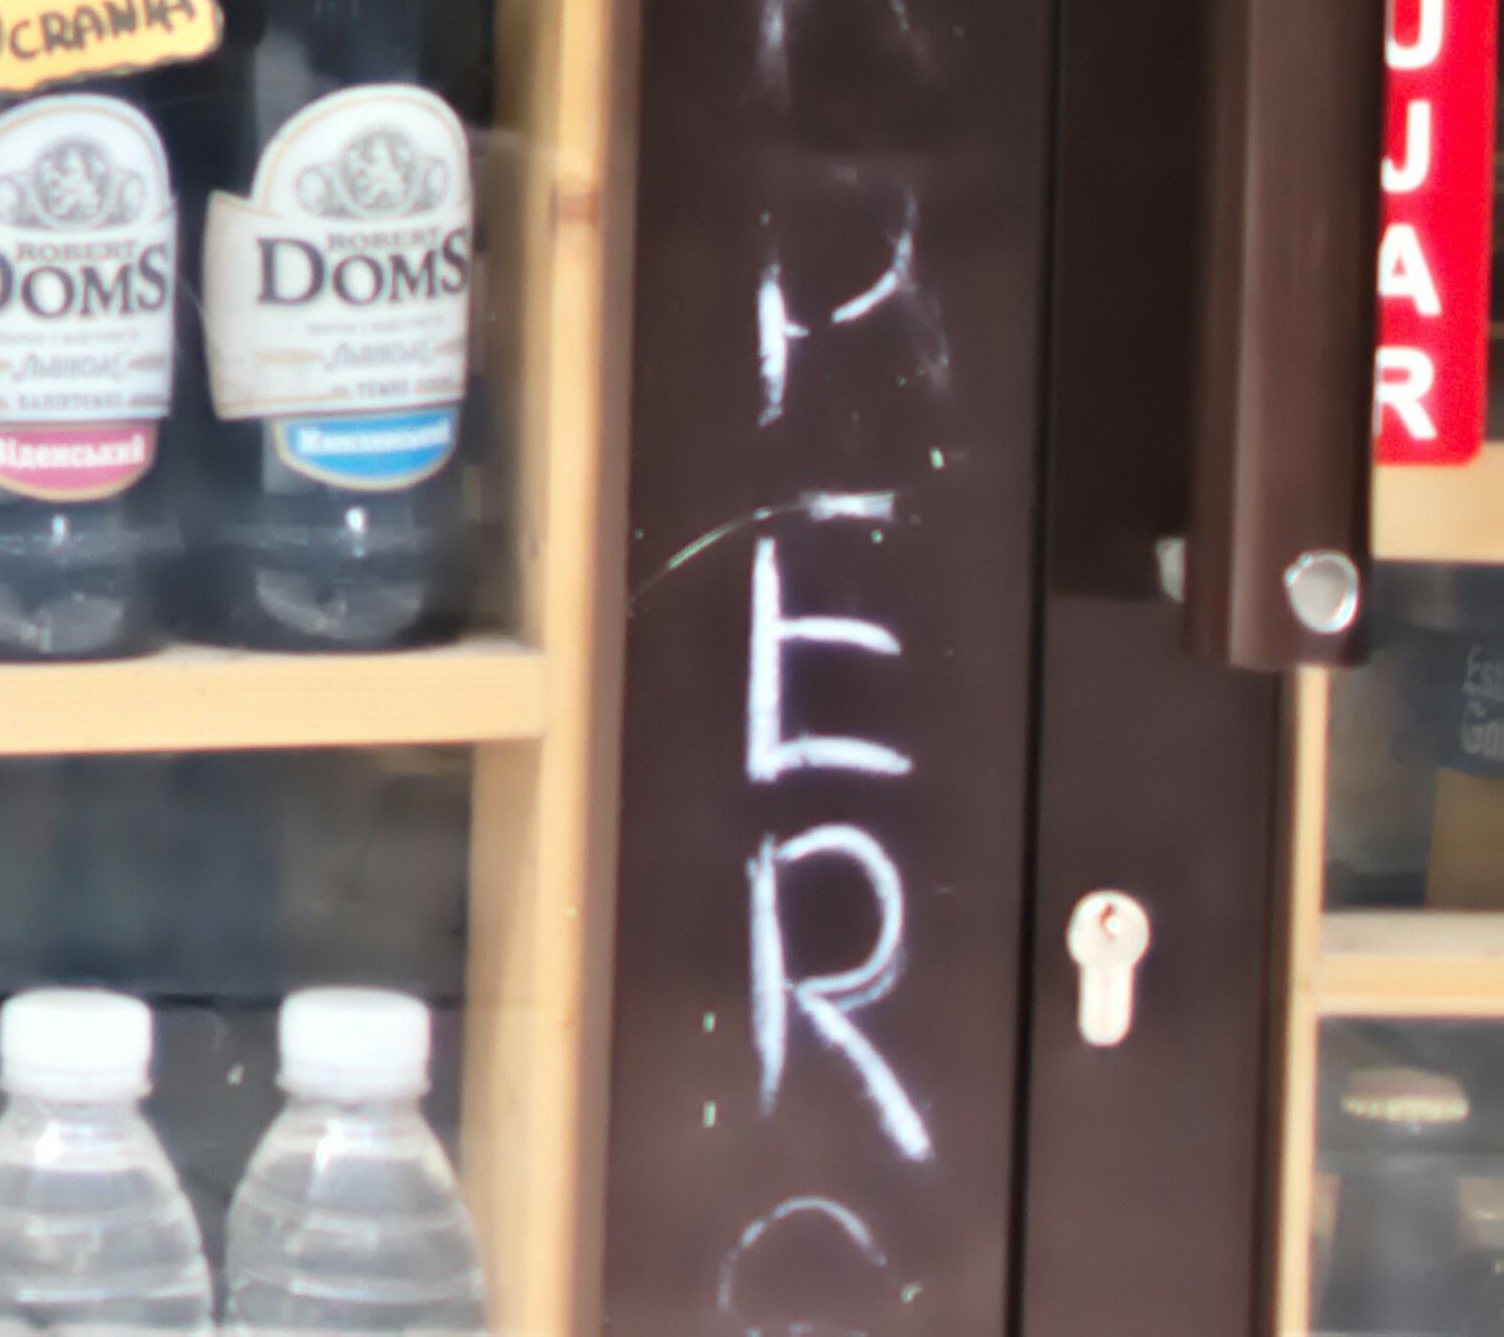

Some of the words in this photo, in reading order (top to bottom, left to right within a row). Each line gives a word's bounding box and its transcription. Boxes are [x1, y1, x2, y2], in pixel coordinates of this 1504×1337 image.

[15, 239, 138, 262] ROBERT
[327, 226, 444, 251] ROBERT
[255, 226, 470, 308] DOMS
